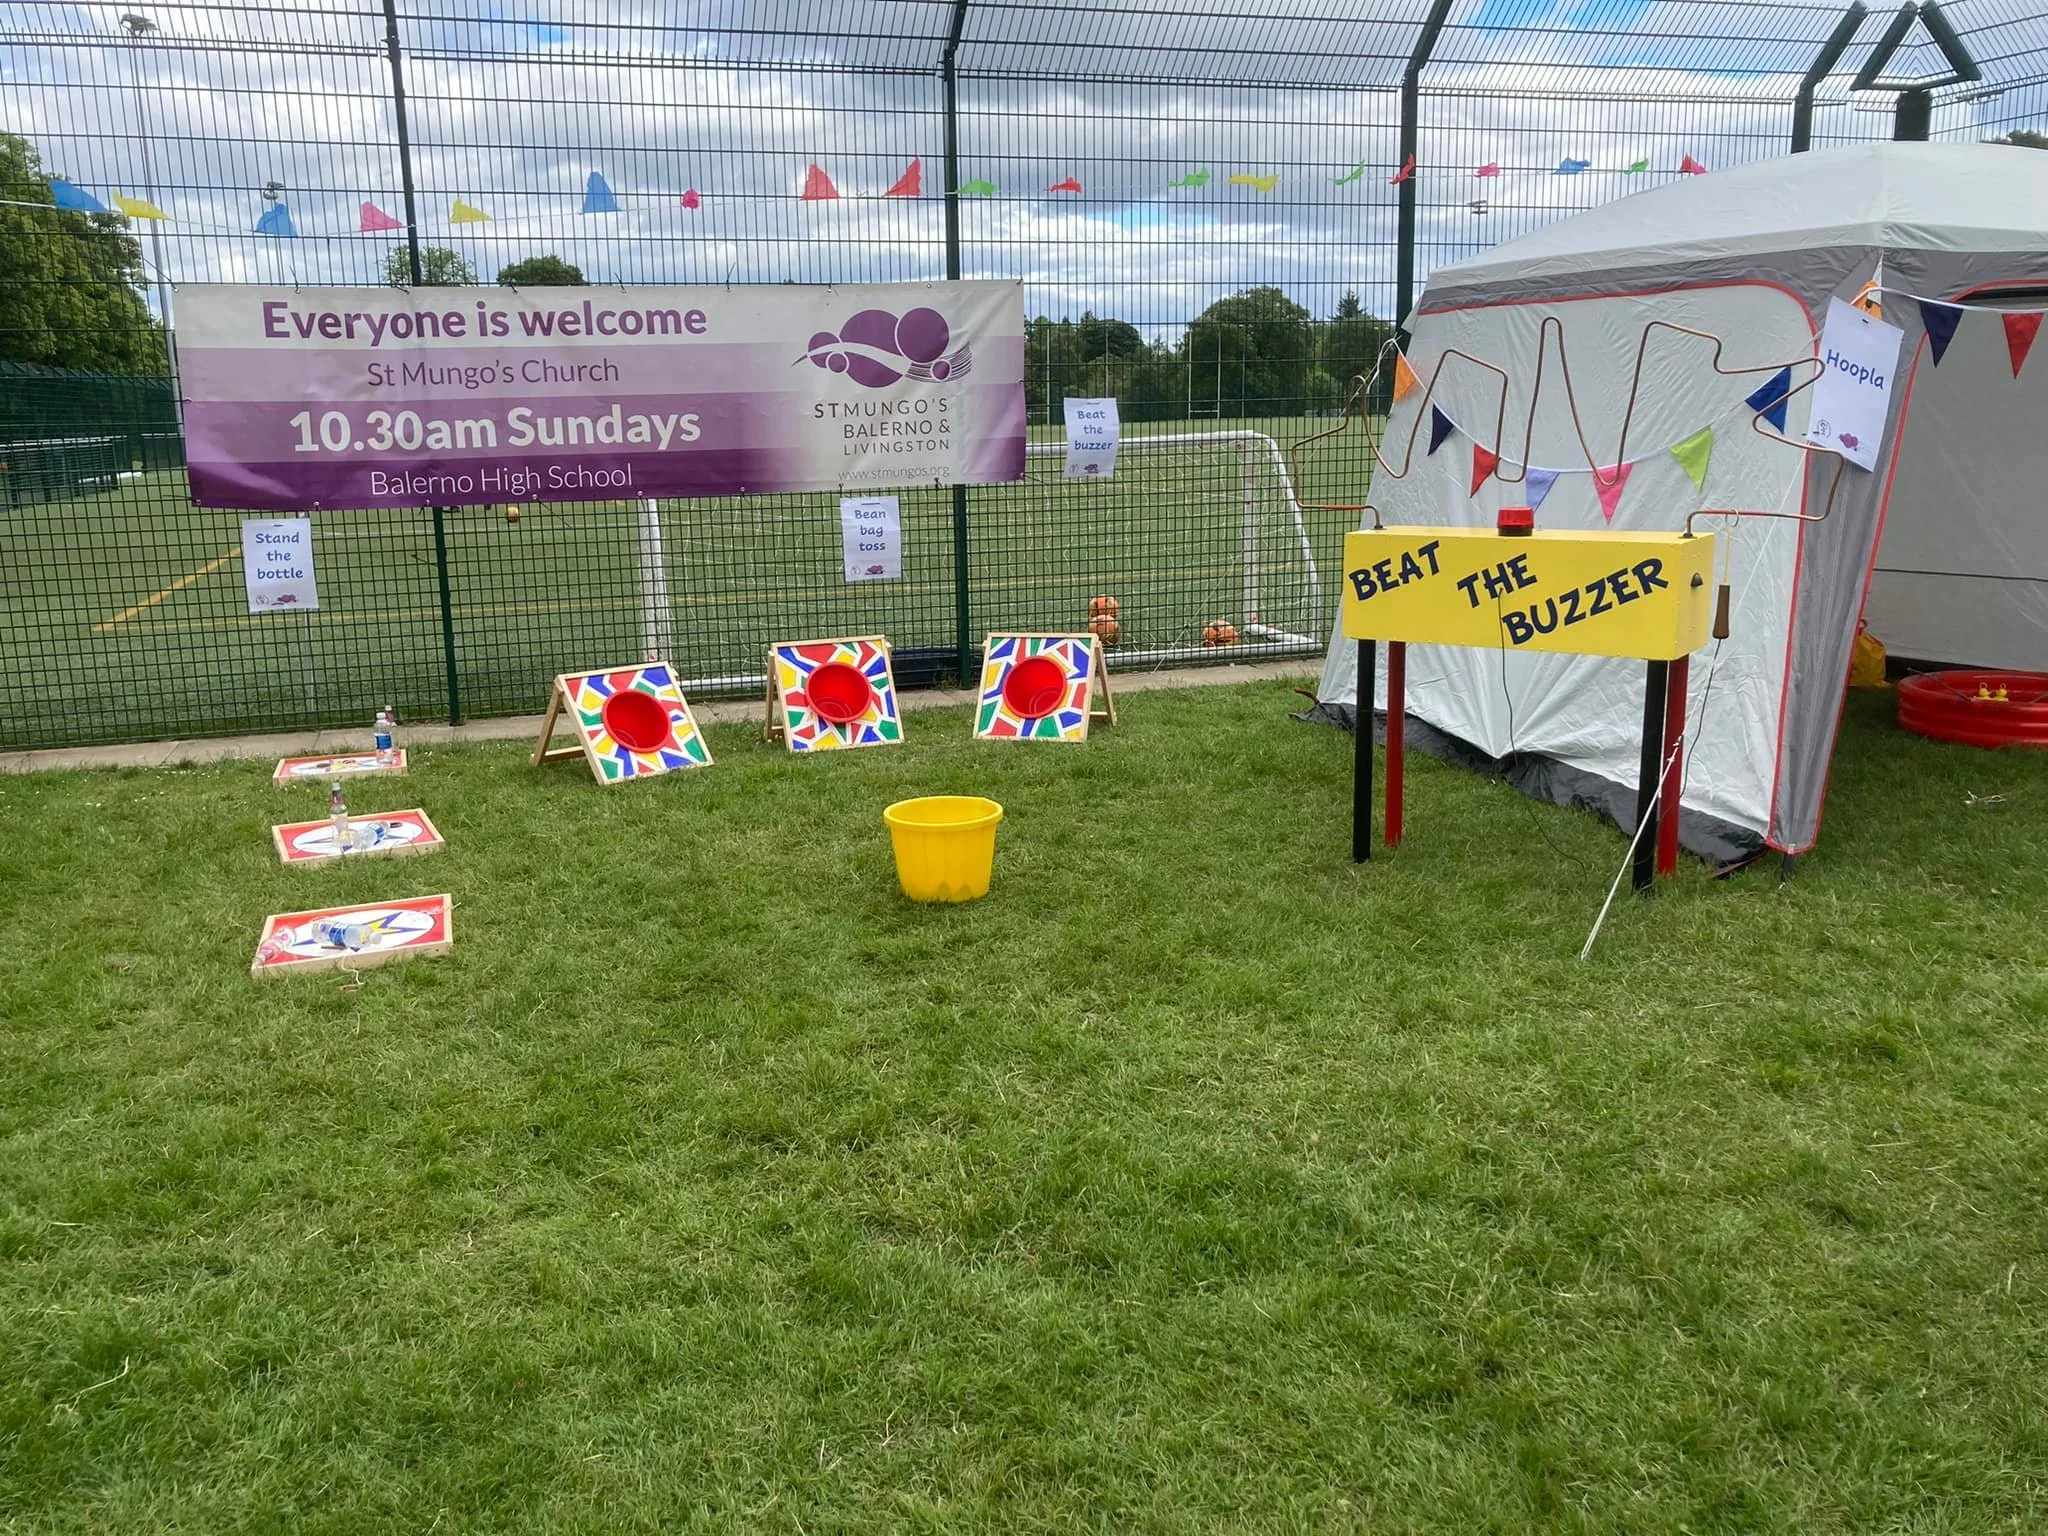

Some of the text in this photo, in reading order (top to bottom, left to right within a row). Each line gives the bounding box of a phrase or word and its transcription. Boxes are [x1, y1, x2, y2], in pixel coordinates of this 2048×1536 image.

[262, 300, 708, 347] Everyone is welcome
[367, 358, 620, 390] St Mungo's Church
[1825, 348, 1885, 391] Hoopla
[1076, 410, 1106, 420] Beat
[289, 403, 702, 452] 10.30am Sundays
[843, 418, 951, 439] BALERNO &
[1083, 424, 1103, 434] the
[843, 439, 950, 456] LIVINGSTON
[1074, 440, 1113, 450] buzzer
[370, 463, 633, 496] Balerno High School
[838, 465, 951, 481] www.stmungos.org
[854, 509, 887, 519] Bean
[255, 531, 300, 544] Stand
[860, 524, 884, 538] bag
[859, 542, 886, 551] toss
[266, 550, 292, 561] the
[257, 567, 304, 579] bottle
[1348, 539, 1442, 602] BEAT
[1456, 552, 1539, 609] THE
[1500, 557, 1669, 646] BUZZER
